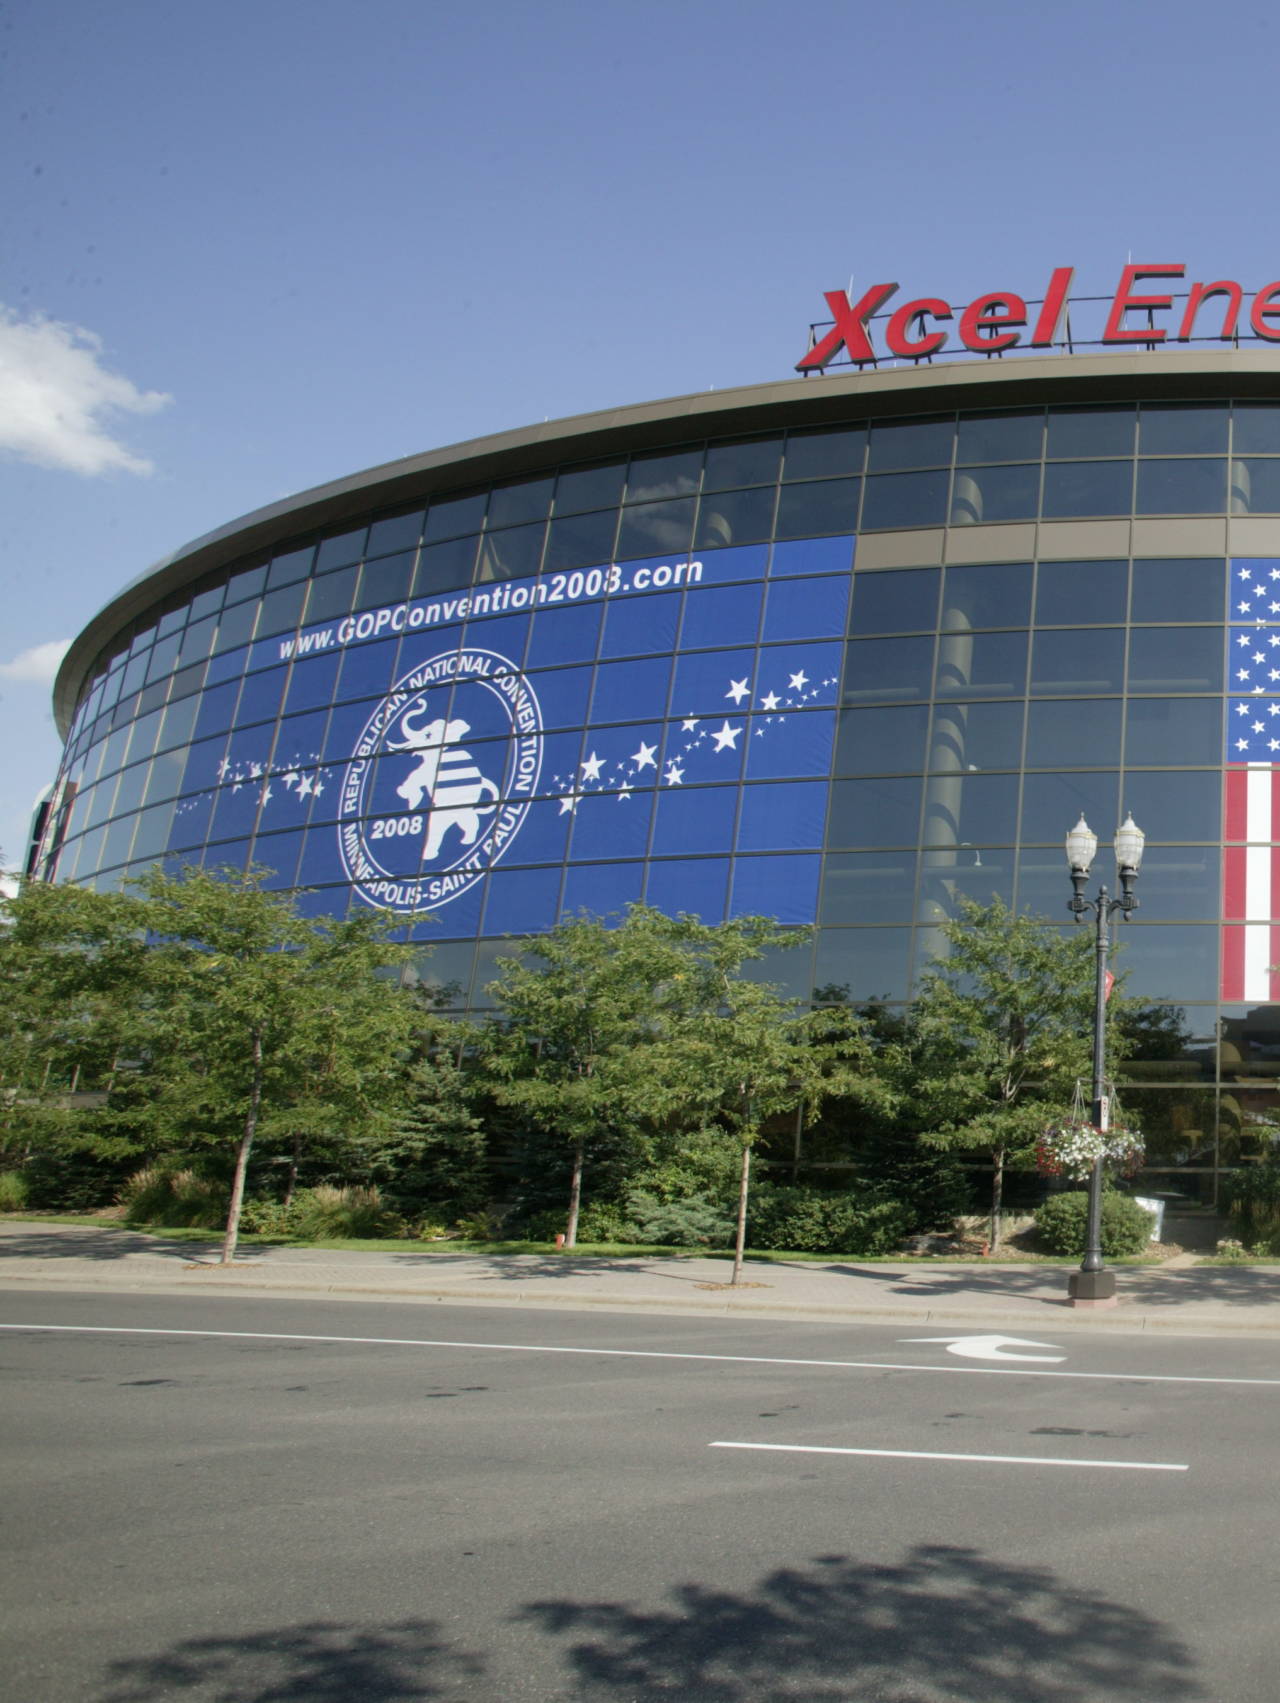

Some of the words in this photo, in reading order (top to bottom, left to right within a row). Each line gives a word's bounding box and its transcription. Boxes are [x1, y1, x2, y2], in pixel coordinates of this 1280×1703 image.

[795, 266, 1076, 373] Xcel
[279, 561, 704, 660] www.GOPConvention2008.com
[343, 687, 409, 814] REPUBLICAN
[408, 655, 492, 689] NATIONAL
[492, 666, 537, 792] CONVENTION
[370, 815, 424, 840] 2008
[482, 803, 524, 856] PAUL
